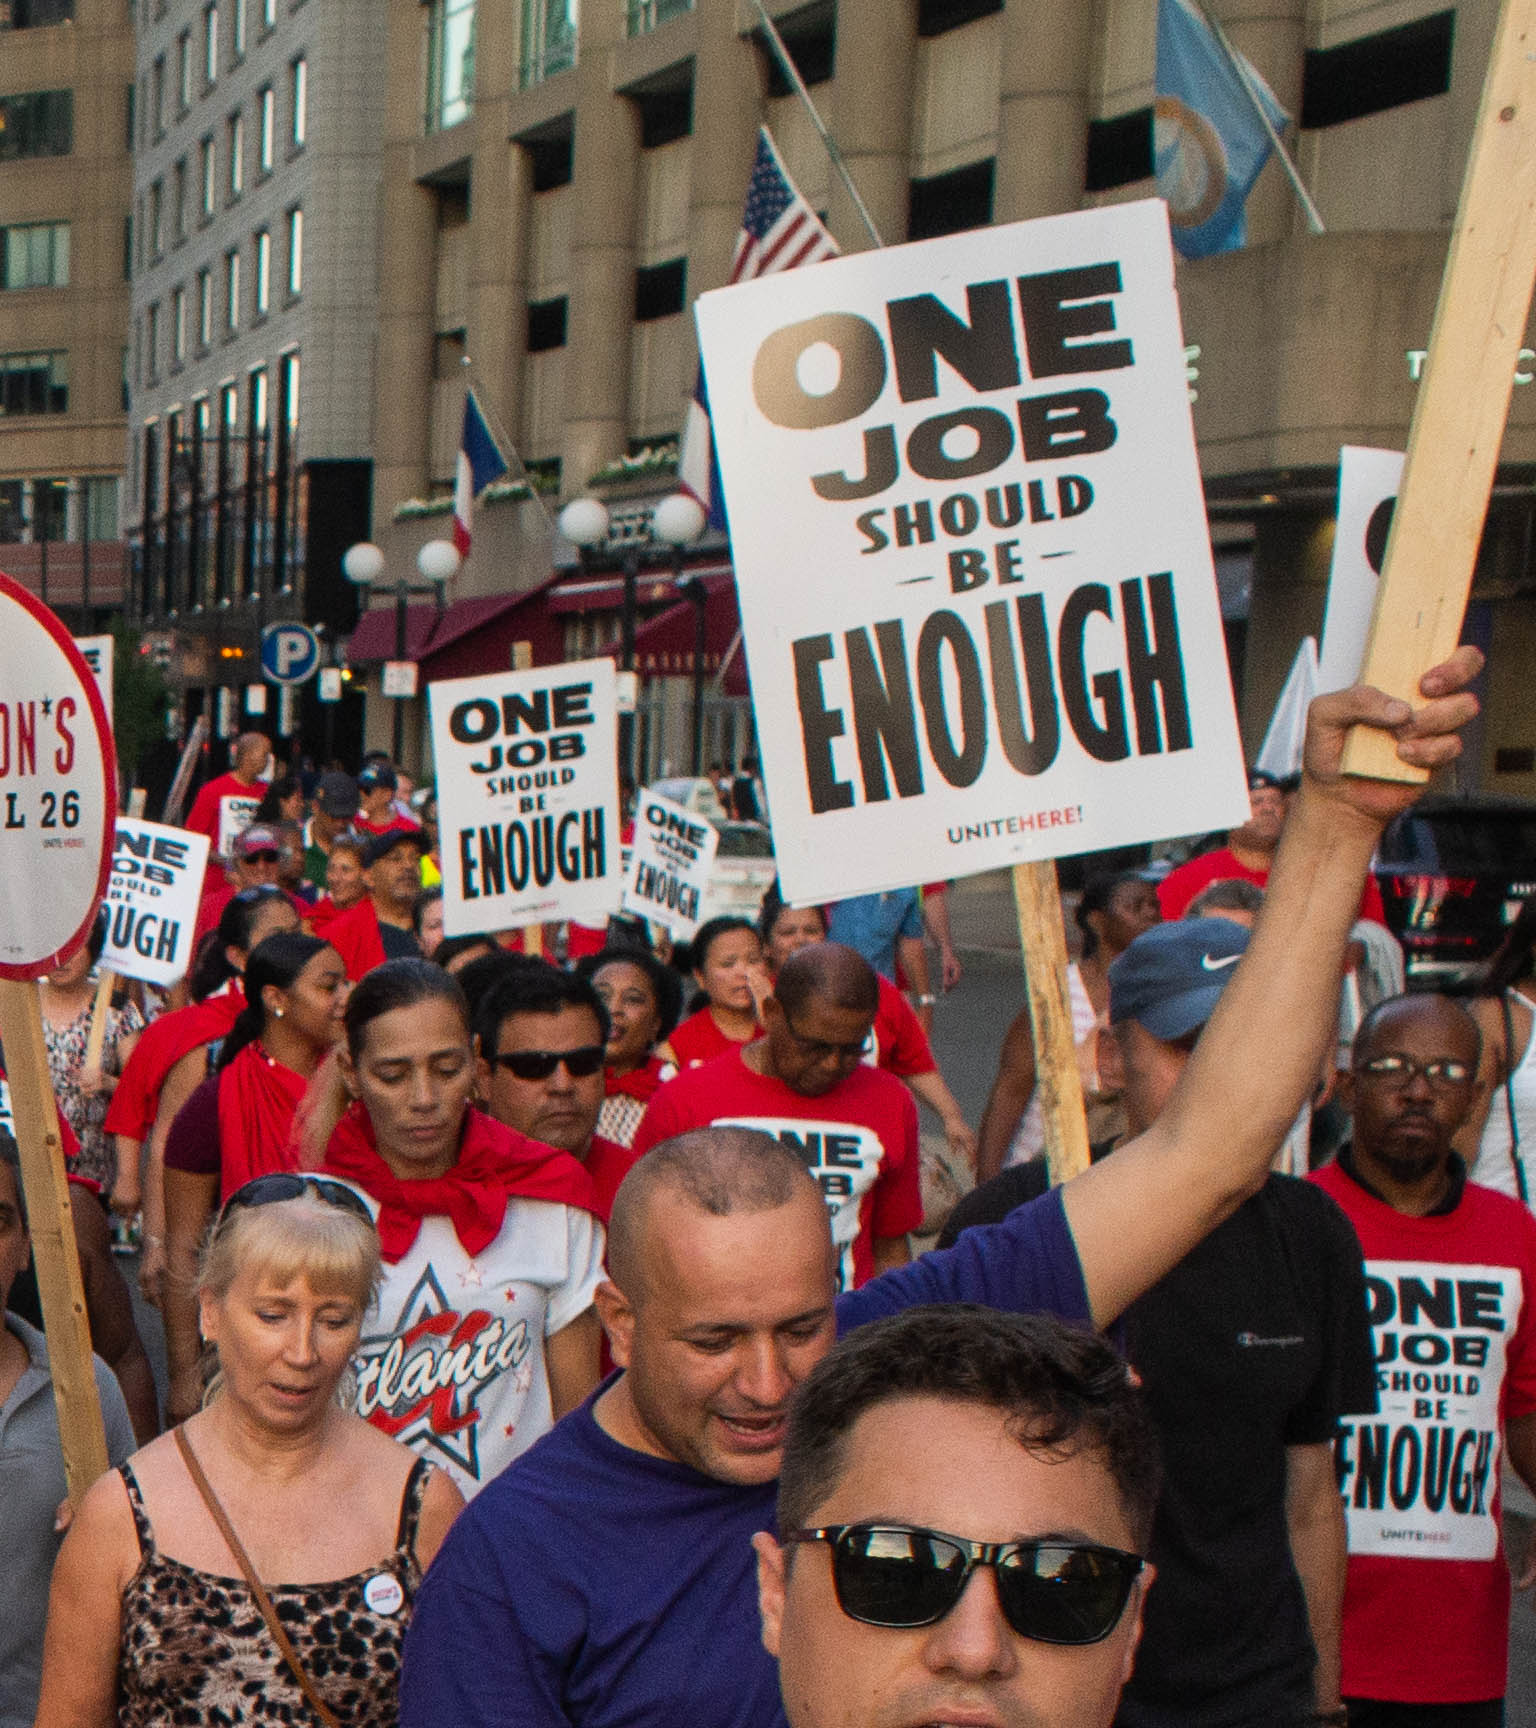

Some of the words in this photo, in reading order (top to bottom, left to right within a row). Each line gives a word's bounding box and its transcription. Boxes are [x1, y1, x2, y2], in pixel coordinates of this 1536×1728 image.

[752, 261, 1134, 430] ONE
[811, 388, 1118, 501] JOB
[856, 475, 1094, 556] SHOULD
[948, 539, 1024, 594] BE
[277, 631, 311, 676] P
[450, 681, 595, 744] ONE
[792, 571, 1194, 815] ENOUGH
[470, 733, 586, 774] JOB
[486, 767, 576, 796] SHOULD
[40, 789, 81, 829] 26
[519, 793, 547, 814] BE
[647, 804, 708, 848] ONE
[947, 806, 1084, 845] UNITEHERE!
[115, 828, 191, 870] NE
[460, 805, 607, 901] ENOUGH
[111, 859, 177, 886] OB
[111, 875, 163, 898] OULD
[766, 1130, 864, 1169] NE
[1377, 1371, 1481, 1396] SHOULD
[1413, 1398, 1448, 1420] BE
[1334, 1423, 1494, 1517] ENOUGH
